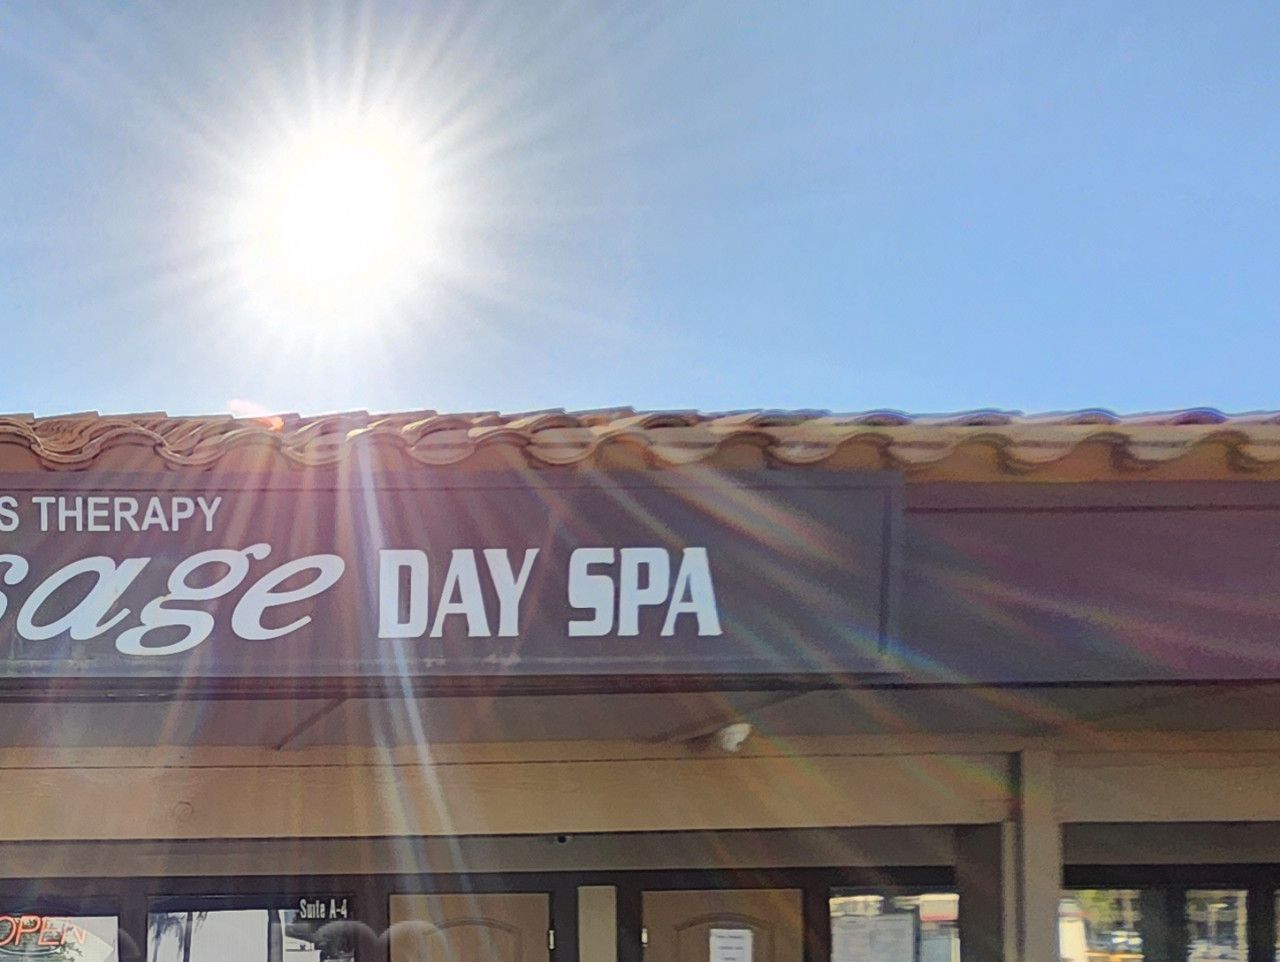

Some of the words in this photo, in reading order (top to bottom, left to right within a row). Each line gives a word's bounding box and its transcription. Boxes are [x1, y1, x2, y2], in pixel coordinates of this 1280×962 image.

[32, 496, 222, 533] THERAPY
[377, 547, 539, 639] DAY
[567, 546, 723, 638] SPA
[299, 898, 326, 919] Suite
[329, 898, 348, 919] A-4
